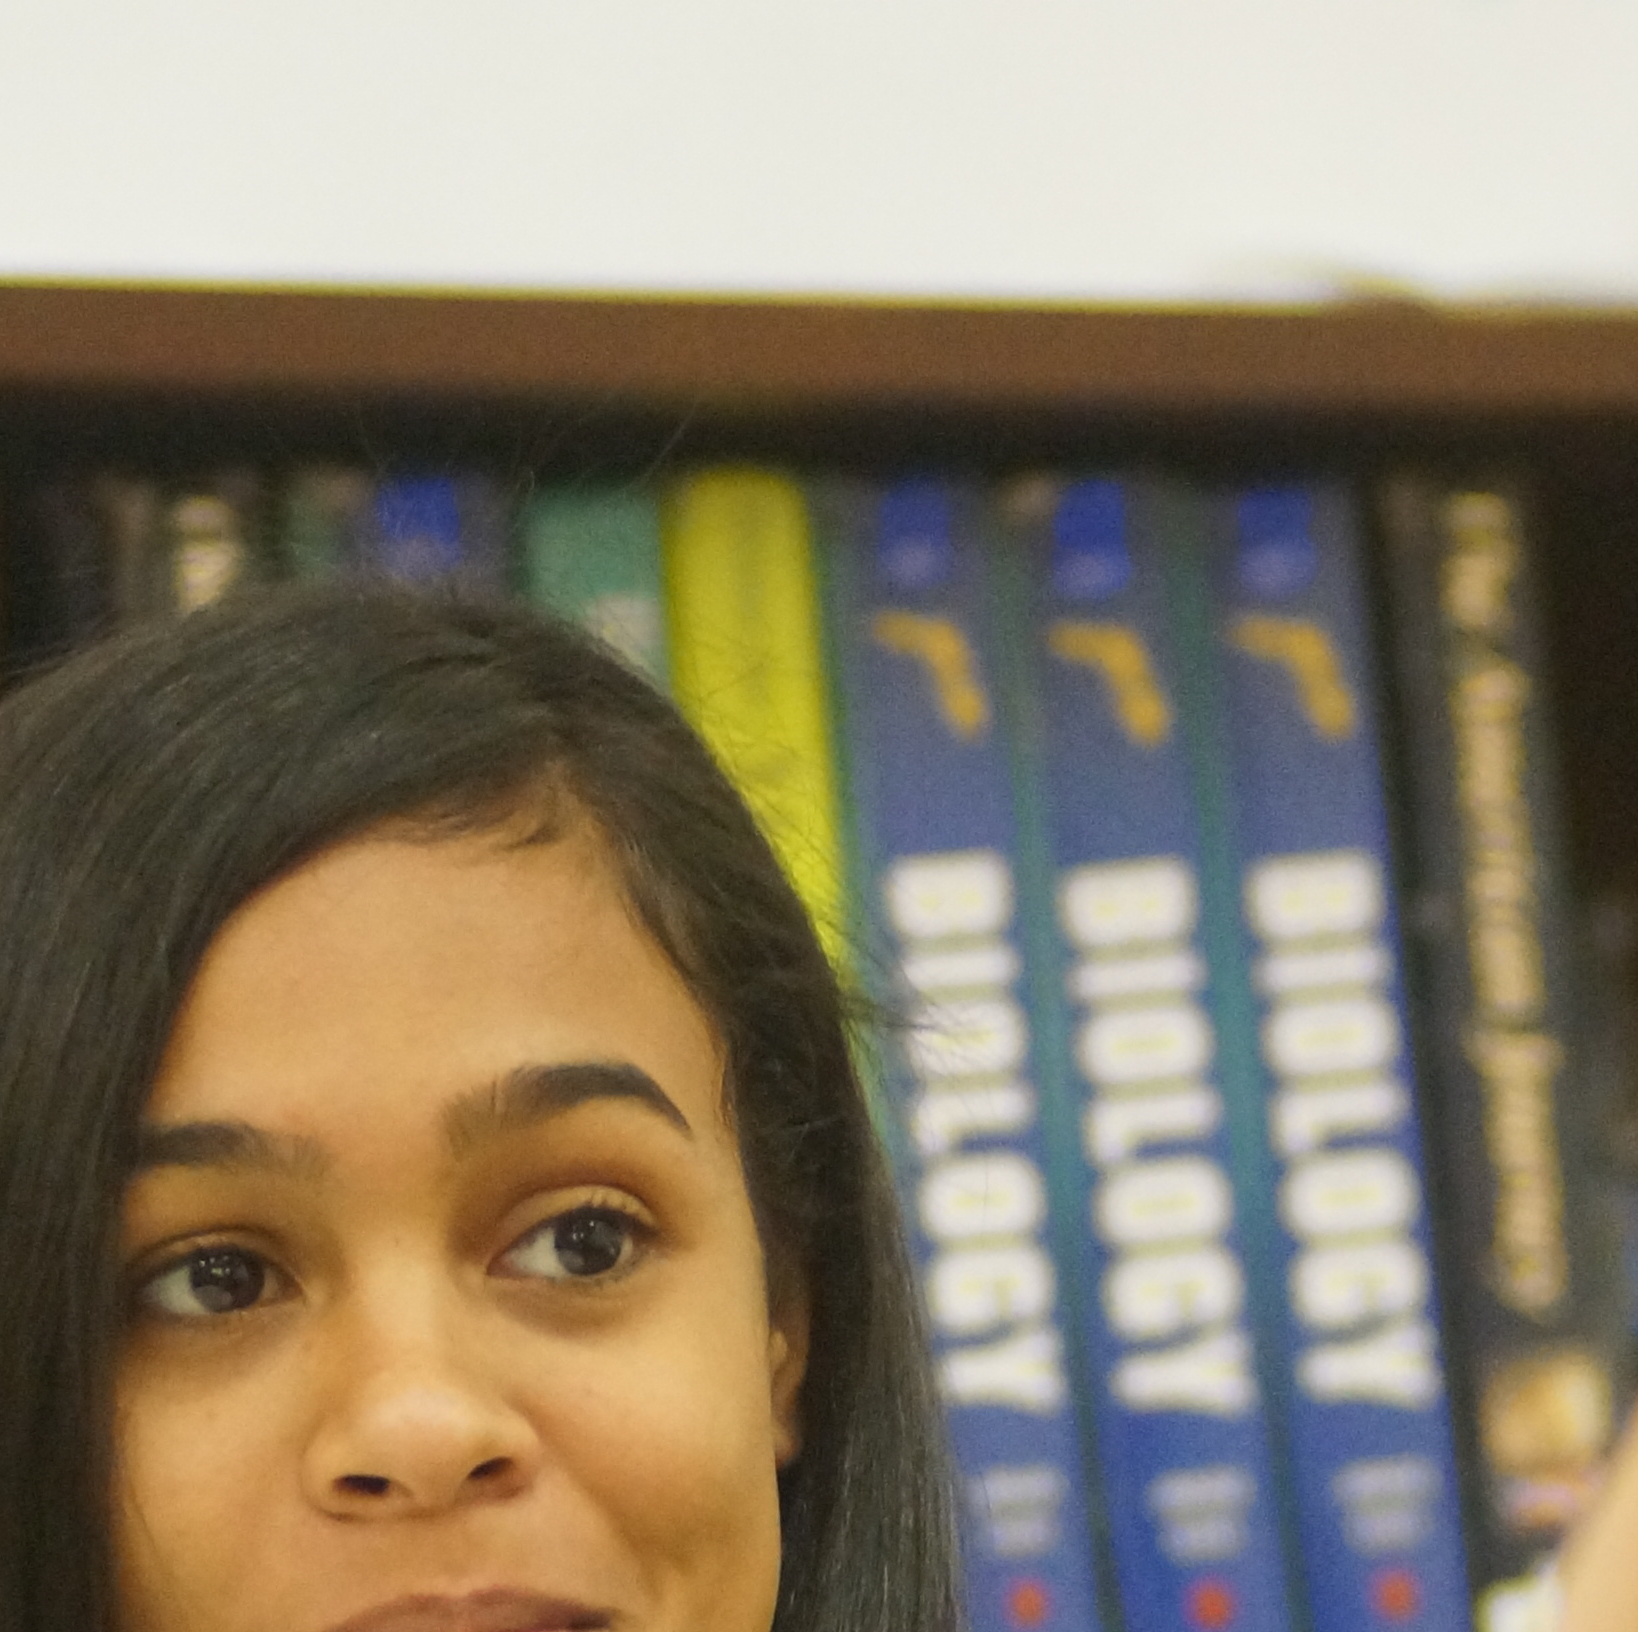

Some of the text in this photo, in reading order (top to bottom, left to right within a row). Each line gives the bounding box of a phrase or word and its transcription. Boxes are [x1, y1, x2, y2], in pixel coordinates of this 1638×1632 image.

[884, 846, 1070, 1420] BIOLOGY
[1057, 853, 1263, 1422] BIOLOGY
[1241, 846, 1446, 1413] BIOLOGY
